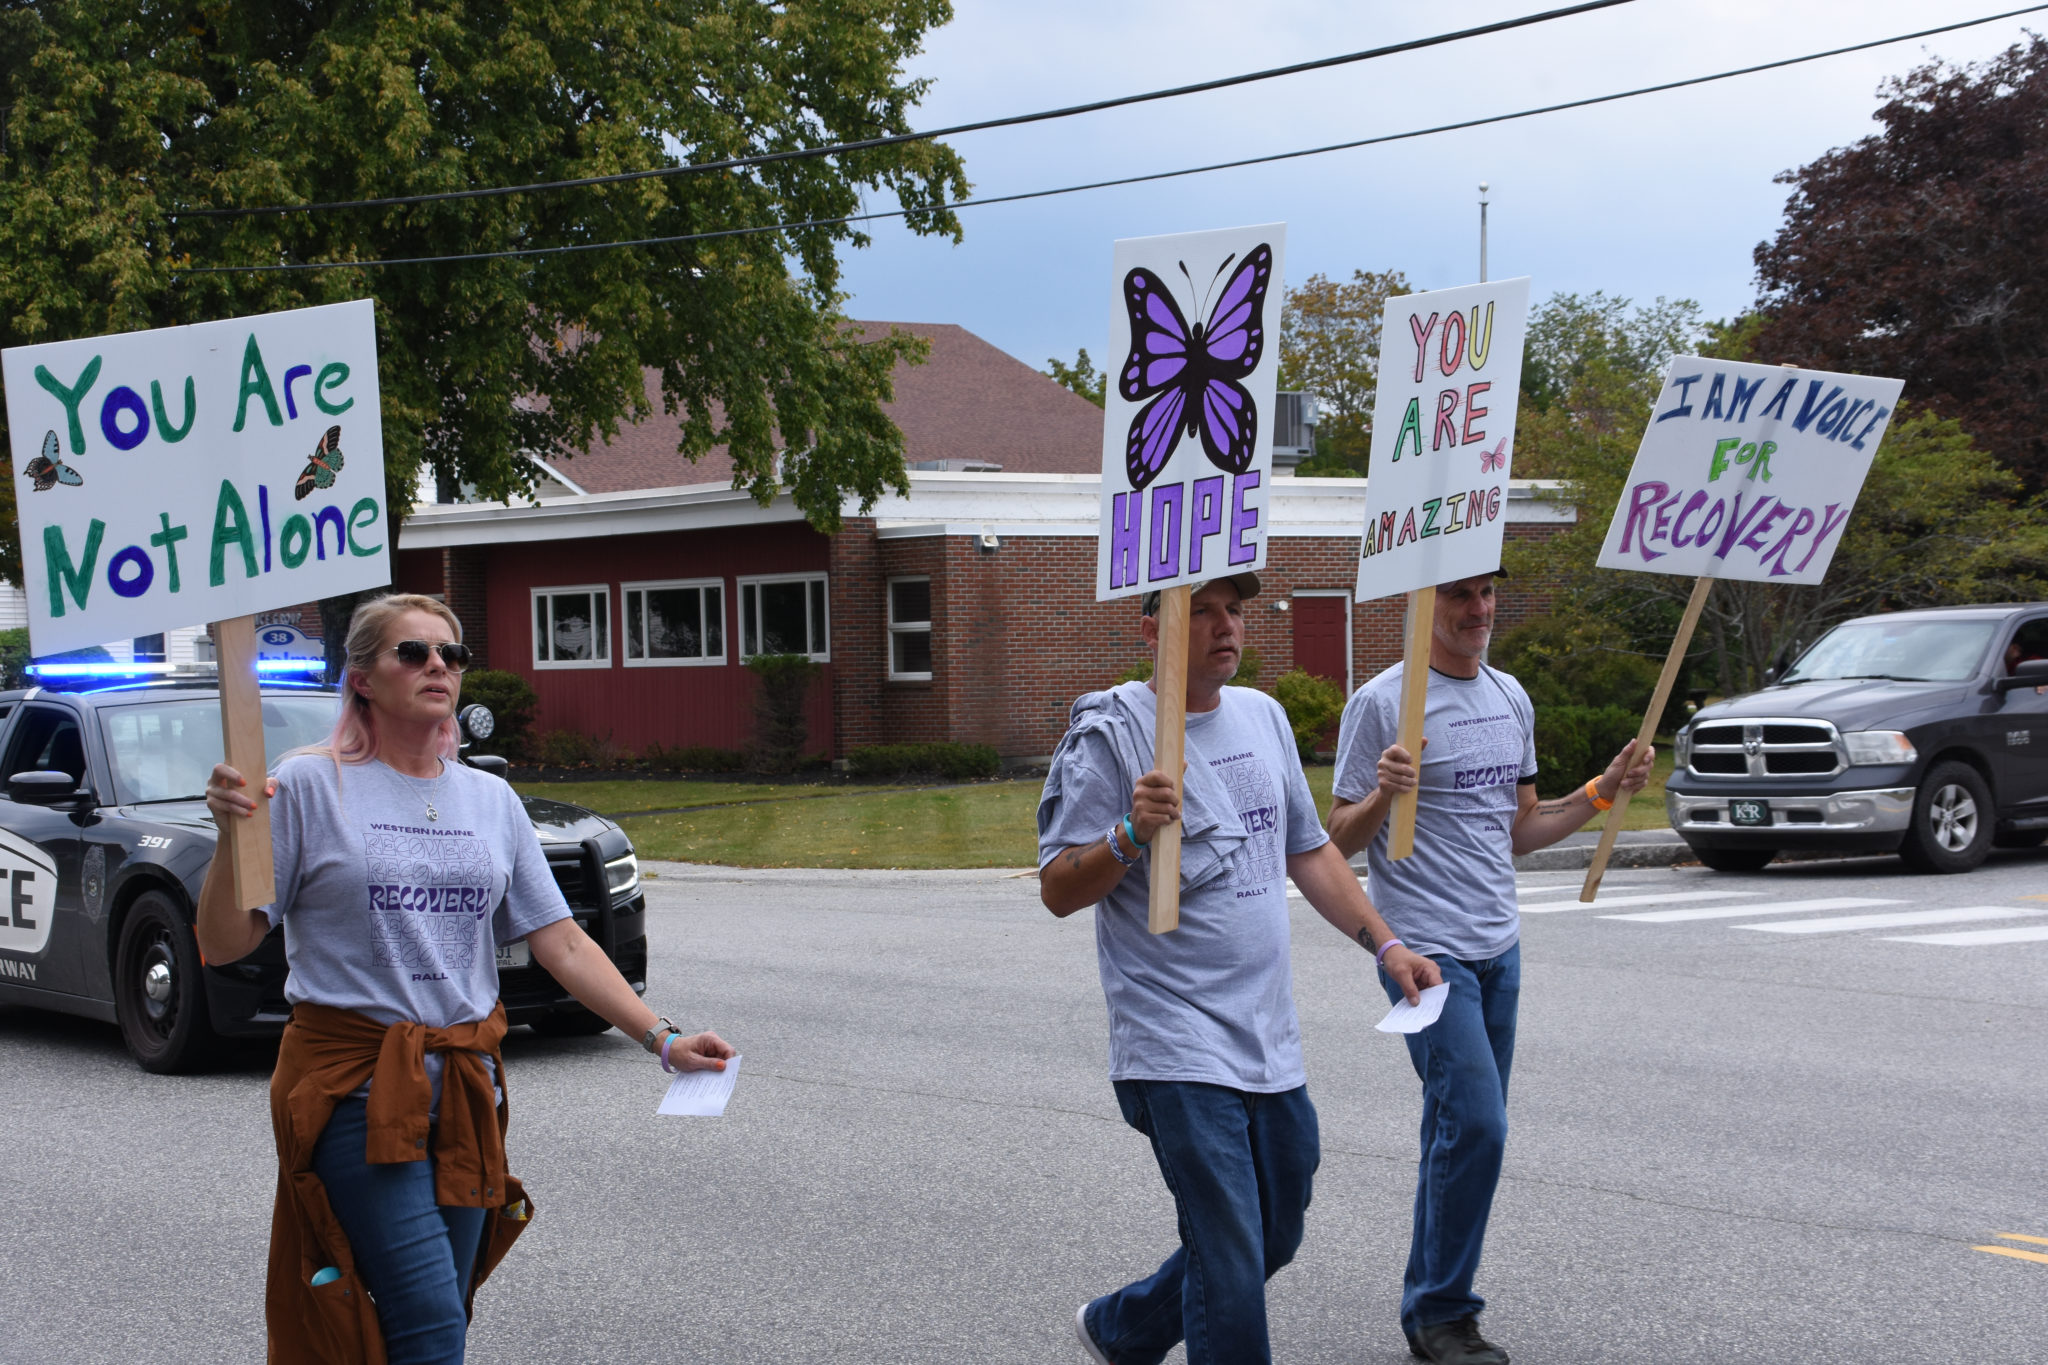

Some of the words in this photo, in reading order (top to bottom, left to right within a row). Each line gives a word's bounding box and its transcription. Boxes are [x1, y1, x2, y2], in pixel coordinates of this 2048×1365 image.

[1409, 300, 1494, 383] YOU
[233, 333, 354, 432] Are
[1393, 382, 1491, 462] ARE
[1655, 373, 1703, 424] I
[1701, 373, 1767, 423] AM
[1759, 378, 1799, 421] A
[1792, 379, 1890, 451] VOICE
[1110, 469, 1261, 590] HOPE
[1363, 486, 1501, 559] AMAZING
[1618, 481, 1850, 577] RECOVERY
[44, 512, 188, 618] Not
[209, 479, 384, 587] Alone
[269, 632, 288, 643] 38
[1448, 719, 1488, 728] WESTERN
[1488, 714, 1511, 722] MAINE
[1222, 751, 1255, 764] MAINE
[1454, 764, 1520, 789] RECOVE
[137, 835, 174, 850] 391
[370, 823, 430, 836] WESTERN
[432, 829, 476, 837] MAINE
[363, 833, 491, 862] RECOVERY
[366, 857, 493, 887] RECOVERY
[368, 885, 491, 920] RECOVERY
[1236, 886, 1268, 899] RALLY
[412, 972, 448, 982] RALL
